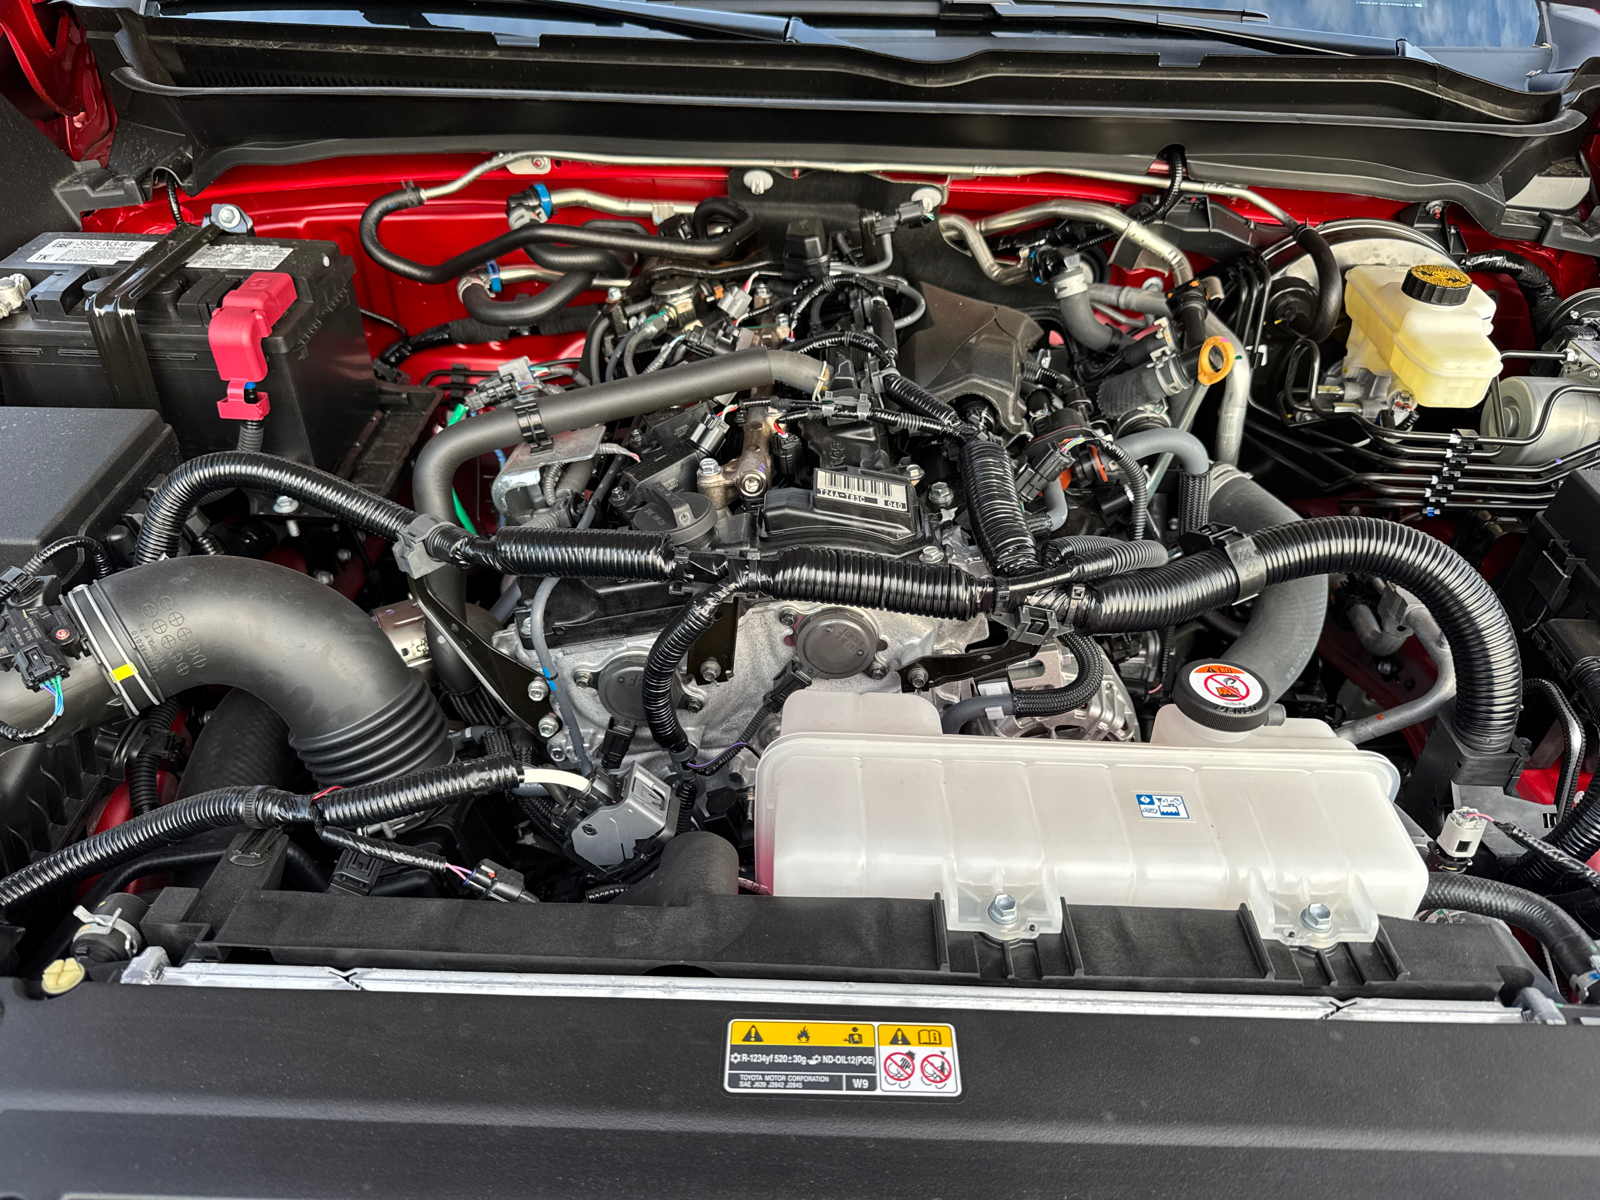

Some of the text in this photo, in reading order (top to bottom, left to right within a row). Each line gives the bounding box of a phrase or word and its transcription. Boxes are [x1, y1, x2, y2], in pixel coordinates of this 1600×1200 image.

[887, 500, 903, 509] 040
[741, 1053, 875, 1066] R-1234yf 520±30g ND-OIL12(POE)
[852, 1078, 869, 1088] W9
